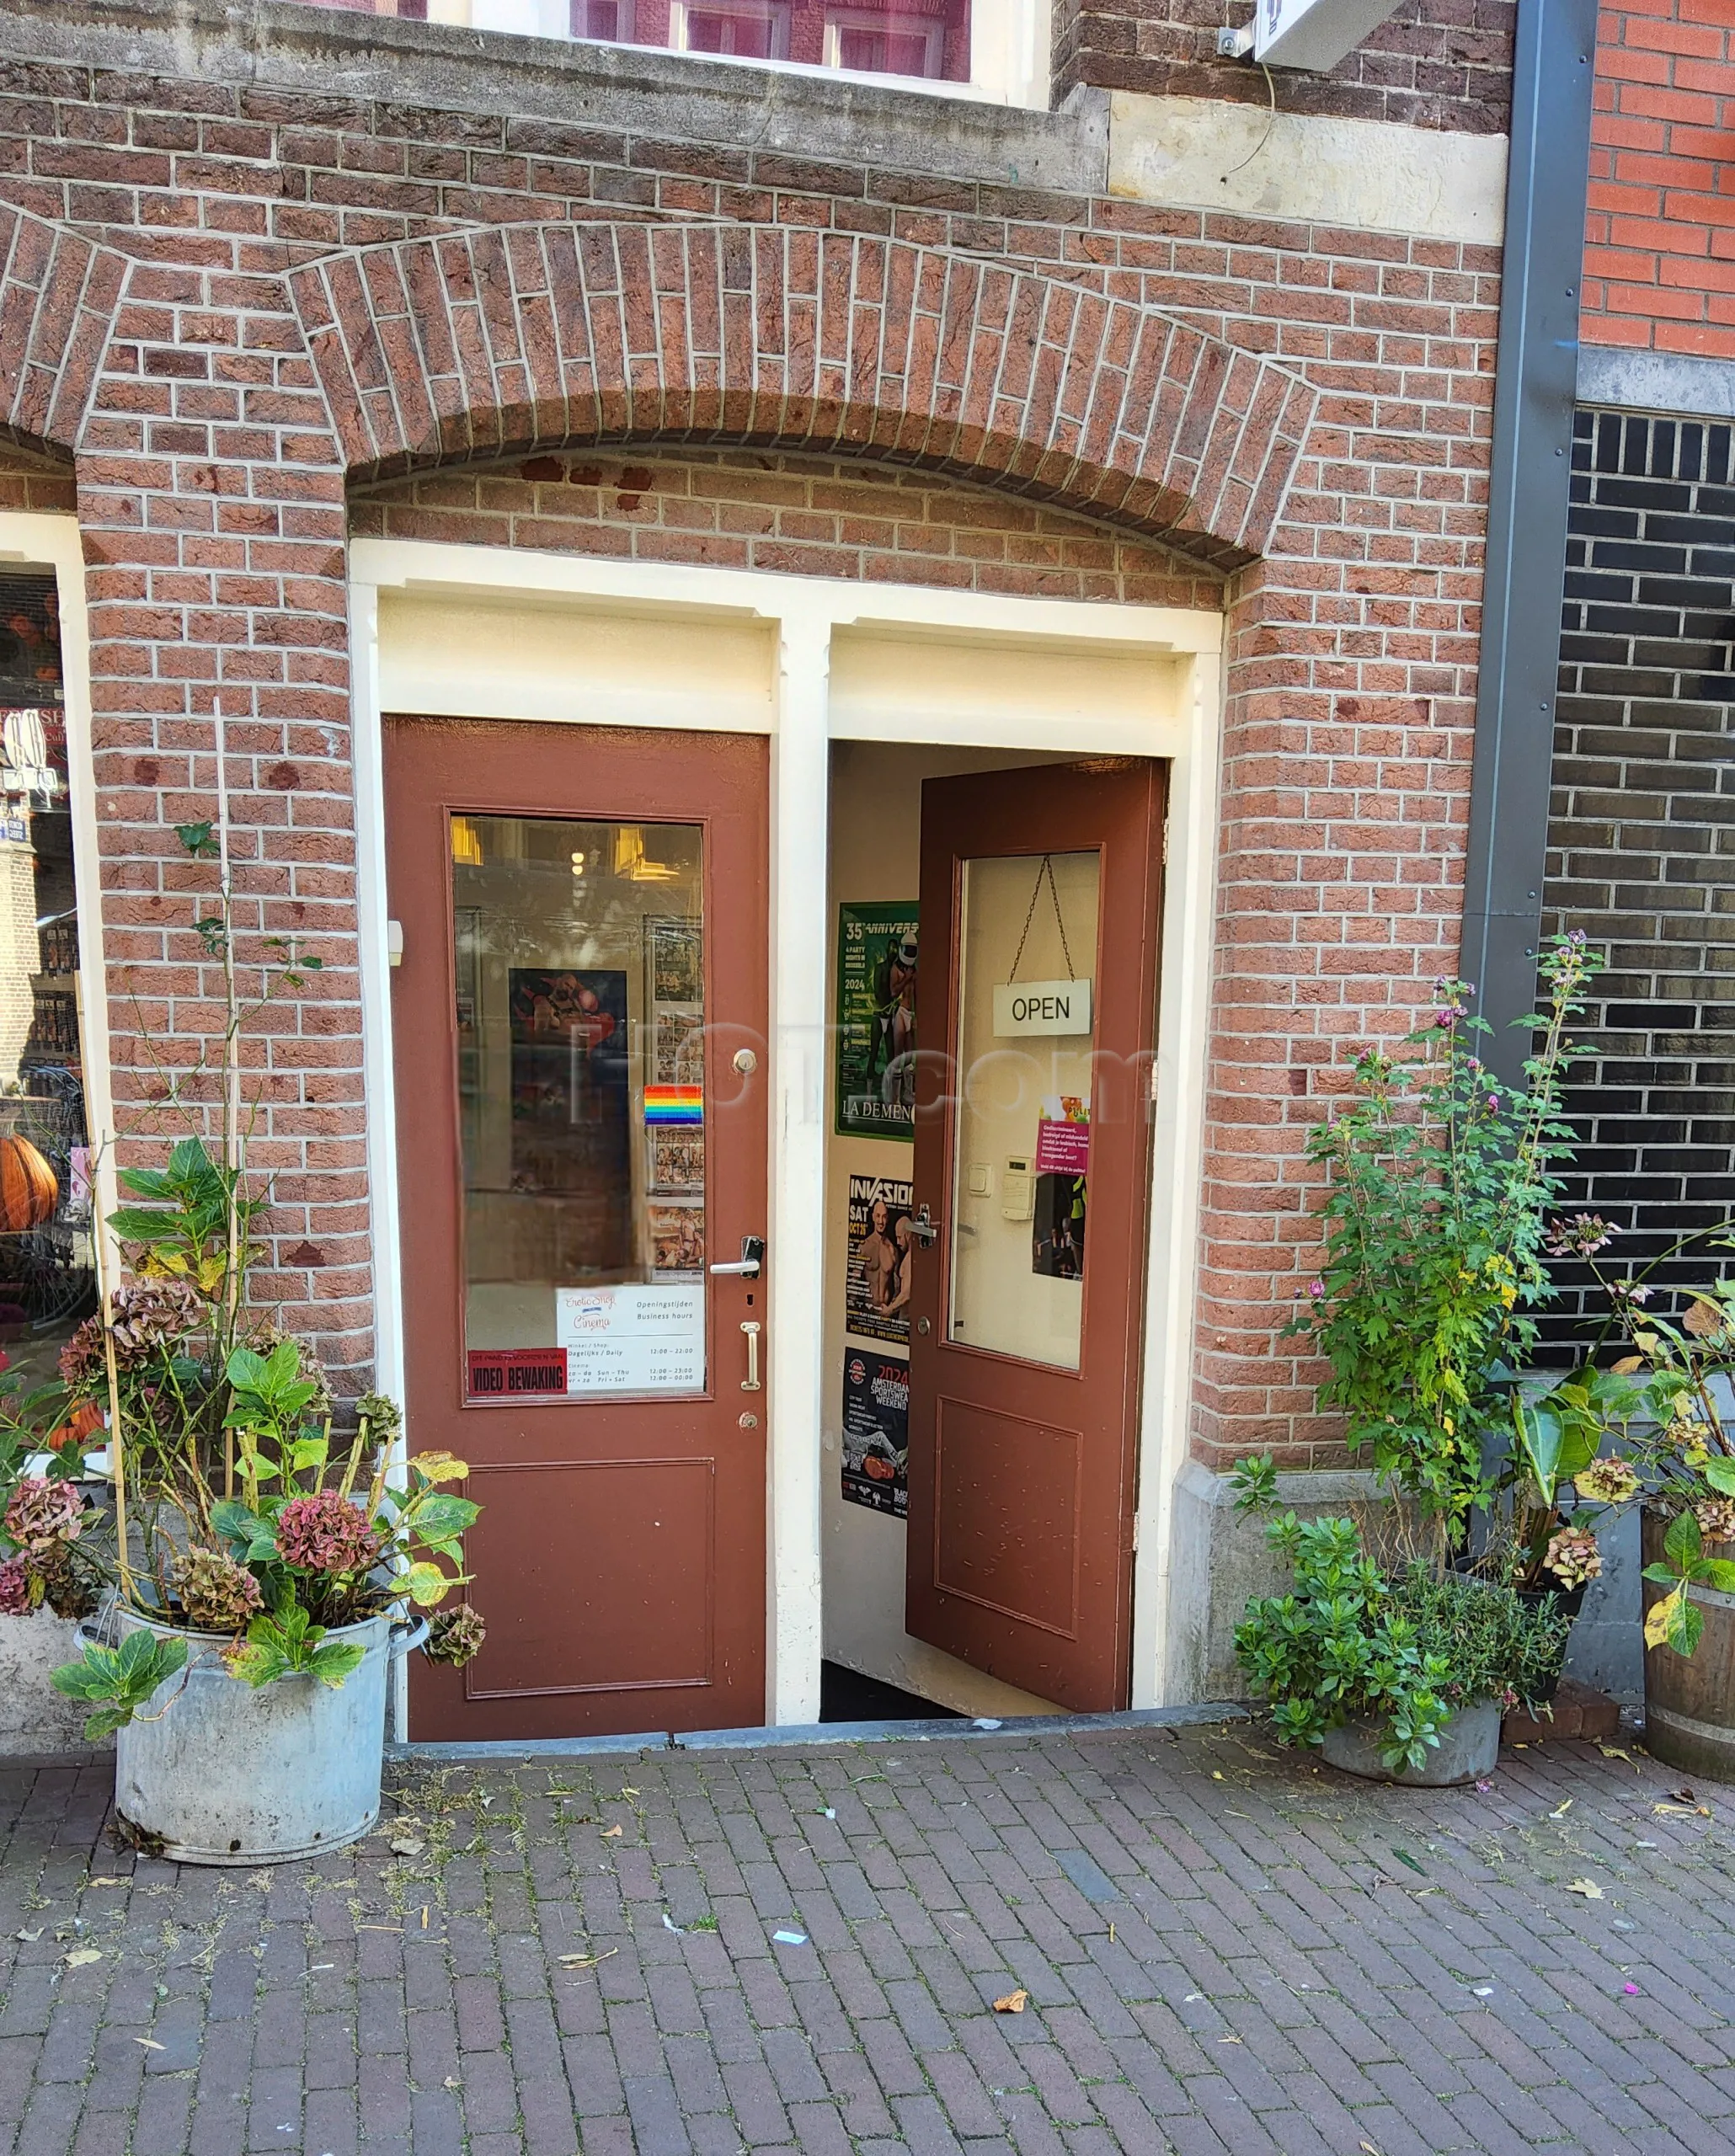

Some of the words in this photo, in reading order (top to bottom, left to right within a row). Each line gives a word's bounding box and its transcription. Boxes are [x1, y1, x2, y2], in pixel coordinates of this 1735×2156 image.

[845, 979, 865, 990] 2024
[1012, 996, 1070, 1022] OPEN
[842, 1100, 860, 1116] LA
[849, 1205, 868, 1222] SAT
[574, 1314, 611, 1331] Cinema
[473, 1367, 503, 1391] VIDEO
[508, 1365, 563, 1390] BEWAKING
[878, 1364, 909, 1384] 2024
[876, 1395, 906, 1411] WEEKEND
